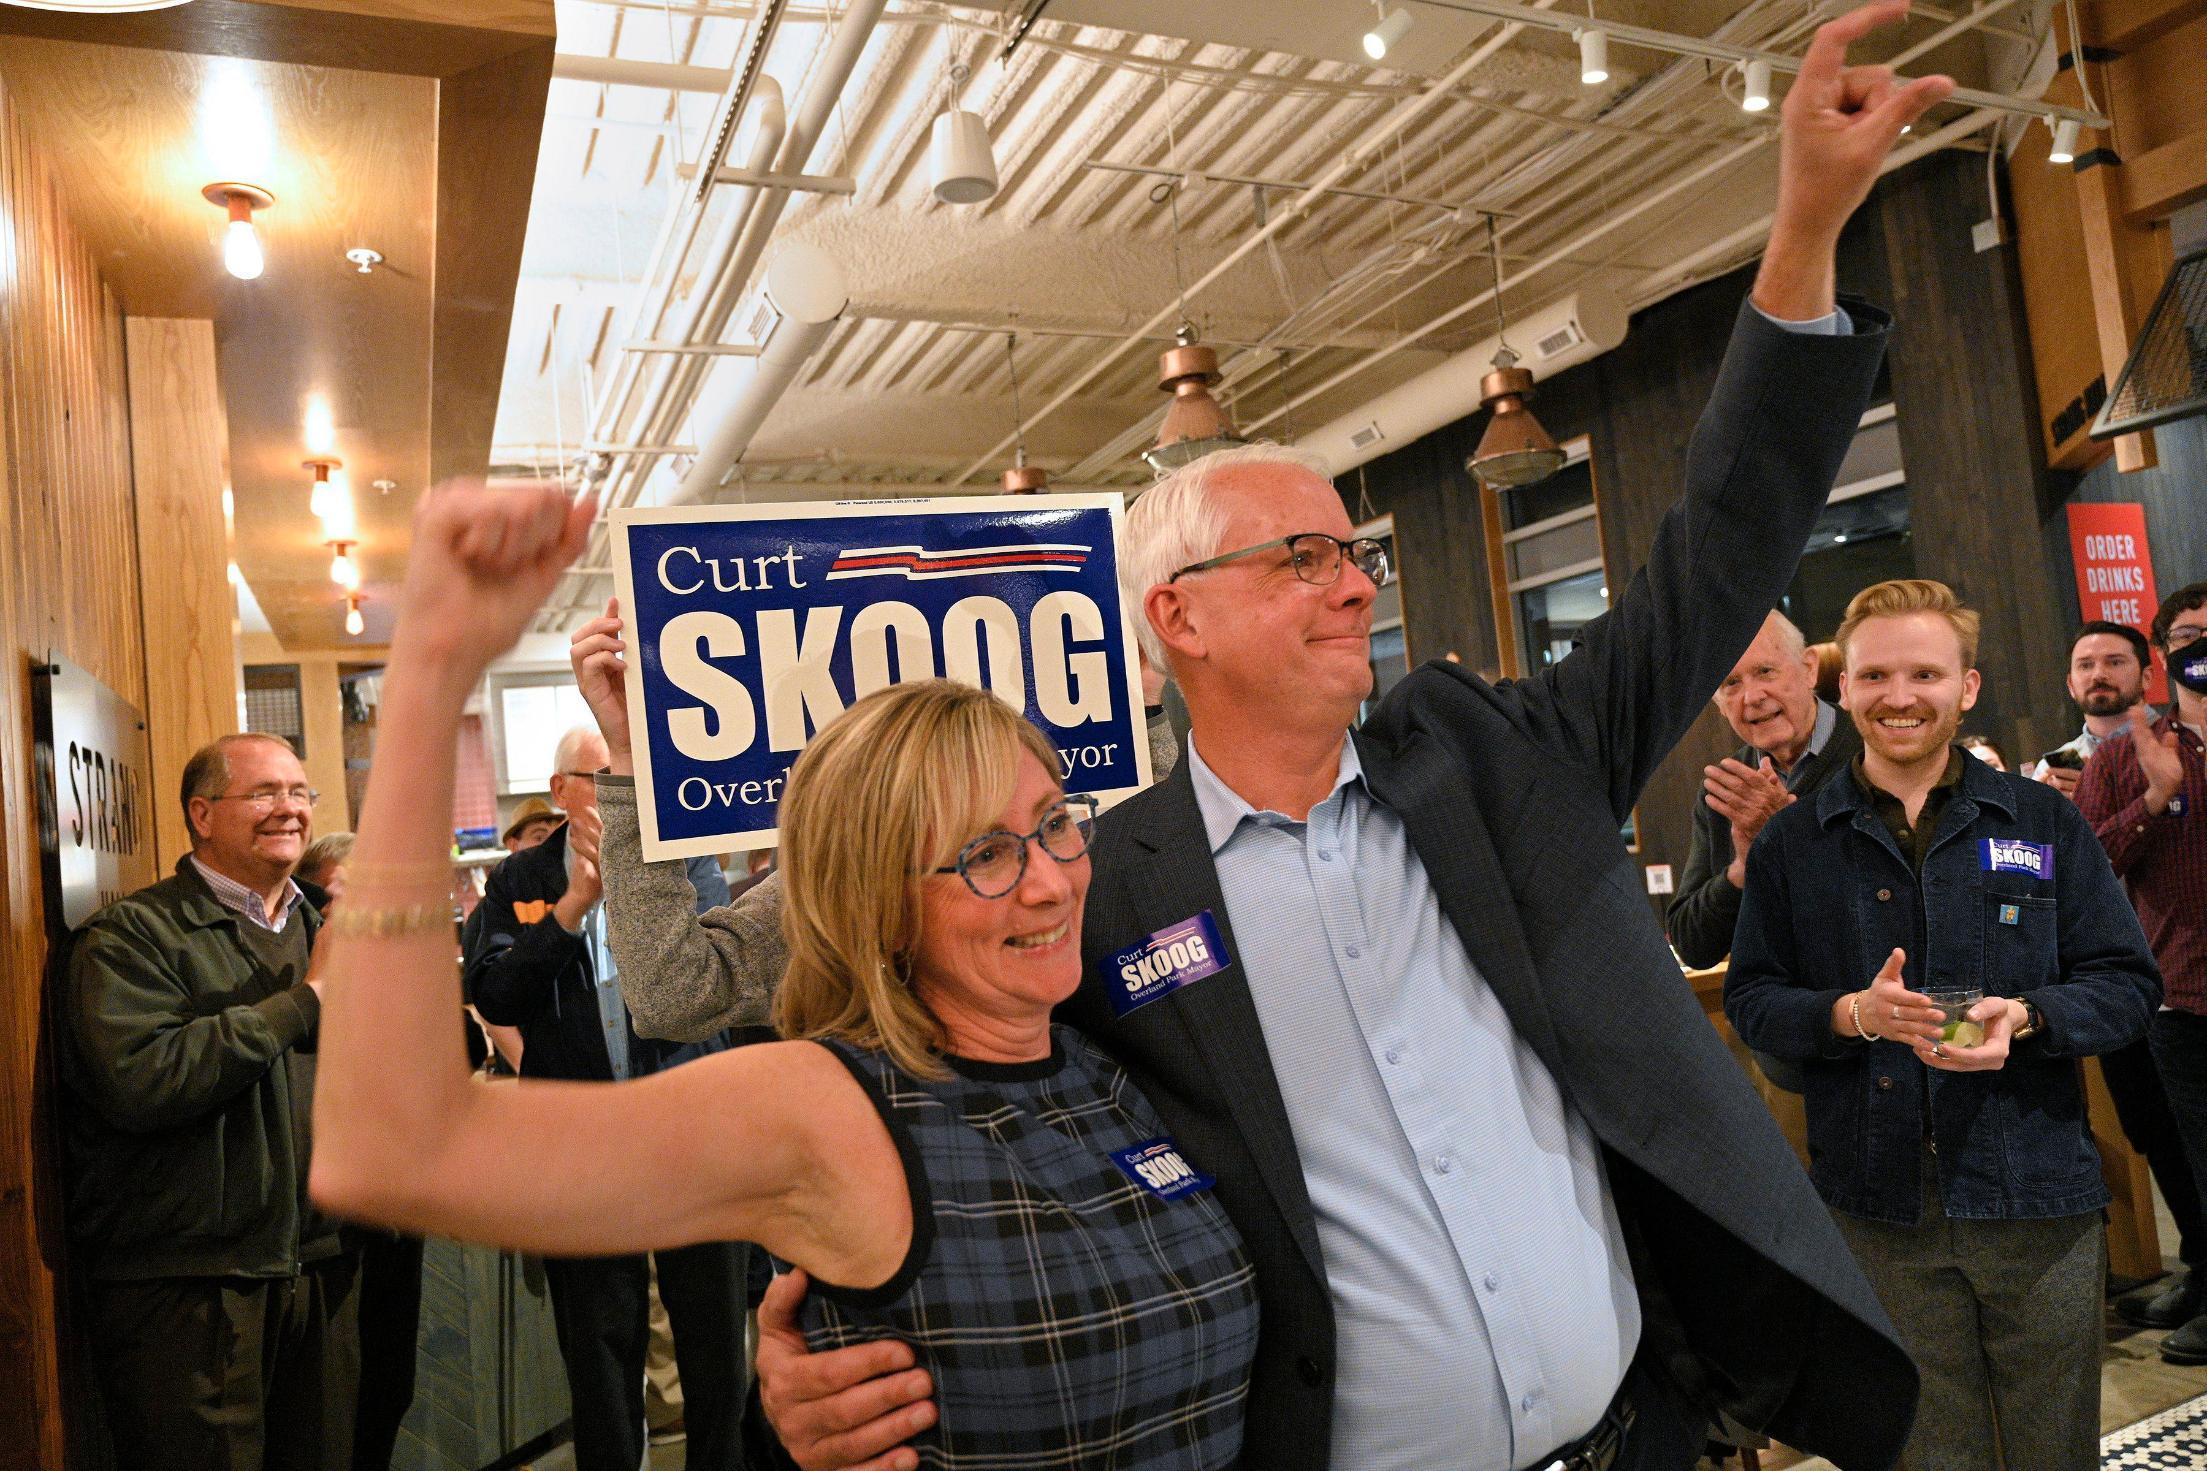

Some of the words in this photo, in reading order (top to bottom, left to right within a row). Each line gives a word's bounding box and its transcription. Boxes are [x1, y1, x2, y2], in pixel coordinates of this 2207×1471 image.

[2085, 534, 2136, 561] ORDER
[656, 545, 807, 595] Curt
[2086, 566, 2145, 593] DRINKS
[2101, 598, 2142, 625] HERE
[659, 590, 1114, 762] SKOOG
[677, 766, 792, 811] Over
[1057, 743, 1117, 780] yor
[1993, 848, 2041, 871] SKOOG
[1117, 948, 1143, 966] Curt
[1120, 935, 1209, 992] SKOOG
[1130, 980, 1166, 1001] Overland
[1166, 972, 1185, 984] Park
[1186, 960, 1212, 975] Mayor
